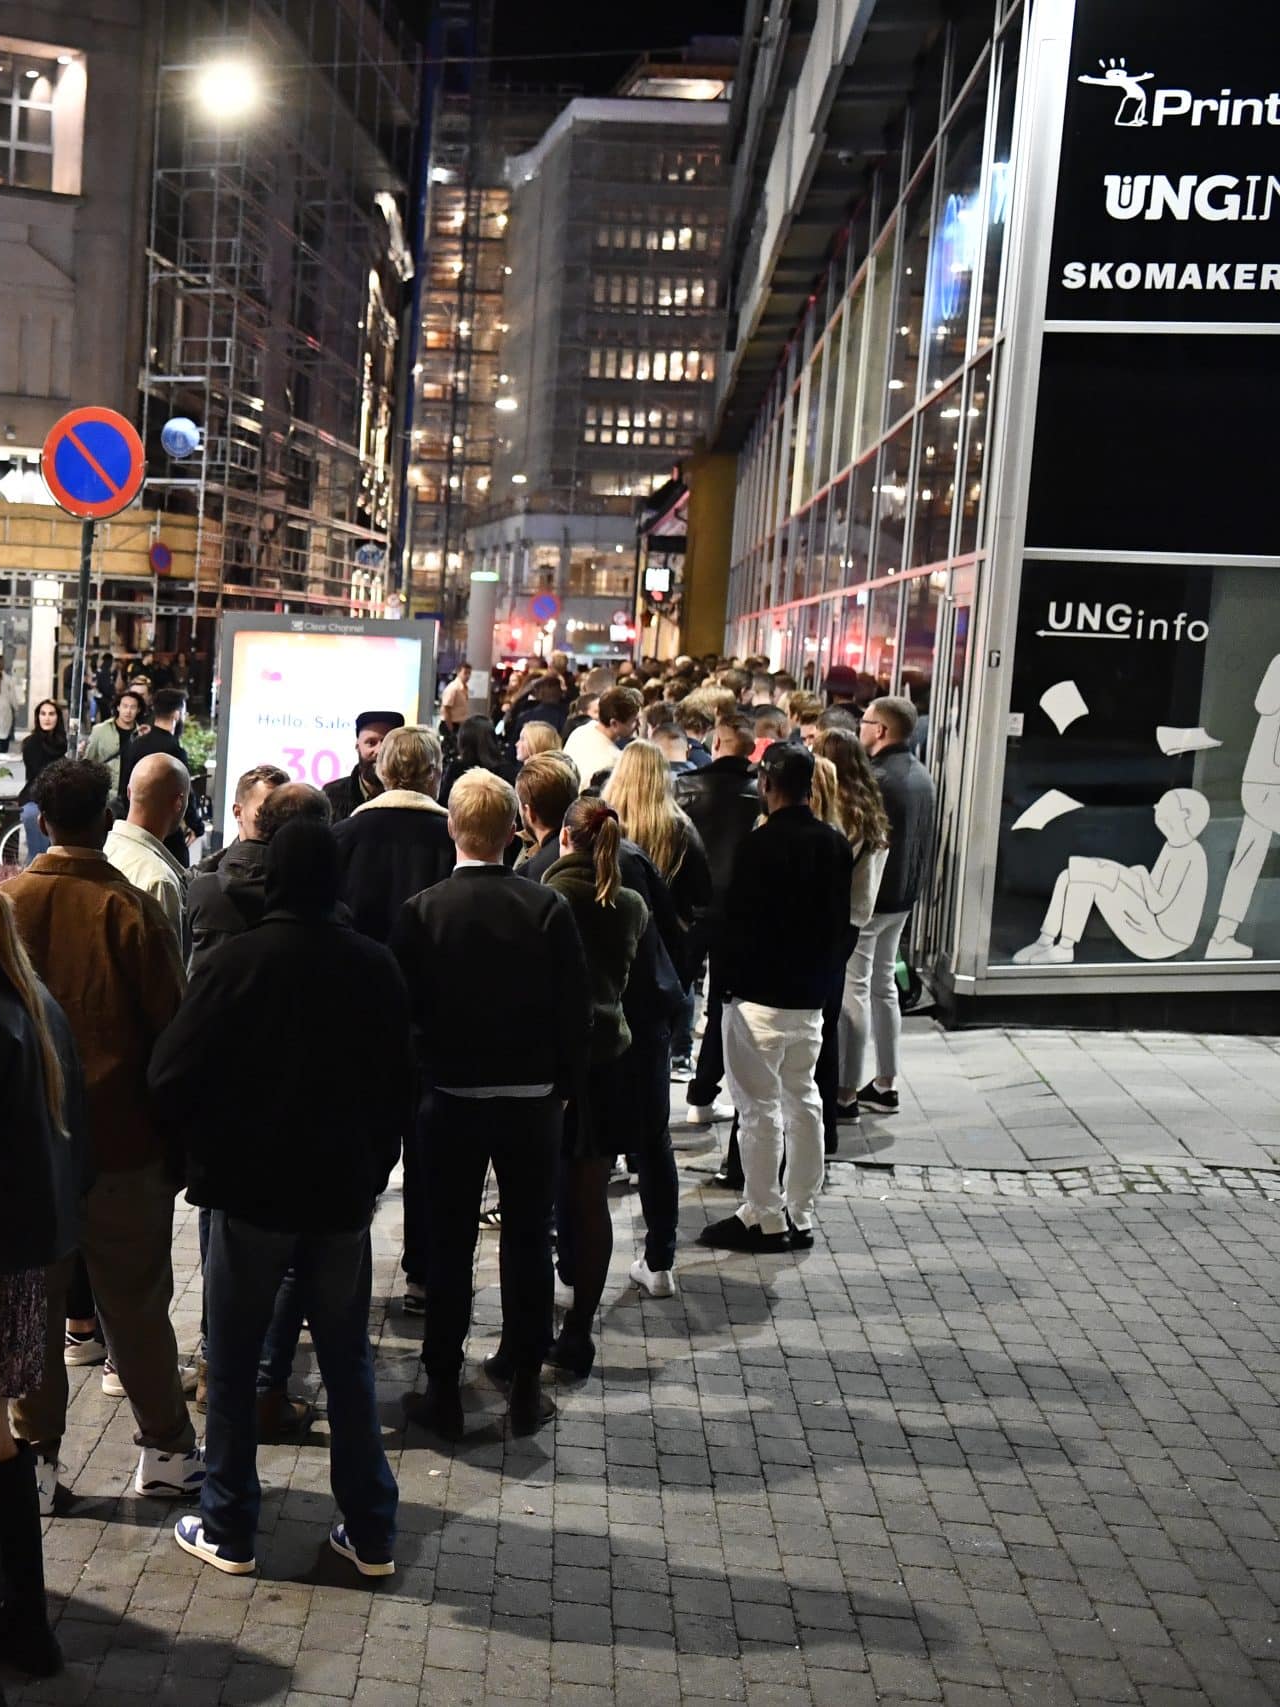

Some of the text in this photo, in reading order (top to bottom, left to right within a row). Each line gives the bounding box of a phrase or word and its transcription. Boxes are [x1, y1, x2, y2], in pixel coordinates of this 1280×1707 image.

[1152, 89, 1280, 126] Print
[1062, 262, 1280, 290] SKOMAKER
[1048, 601, 1210, 642] UNGinfo
